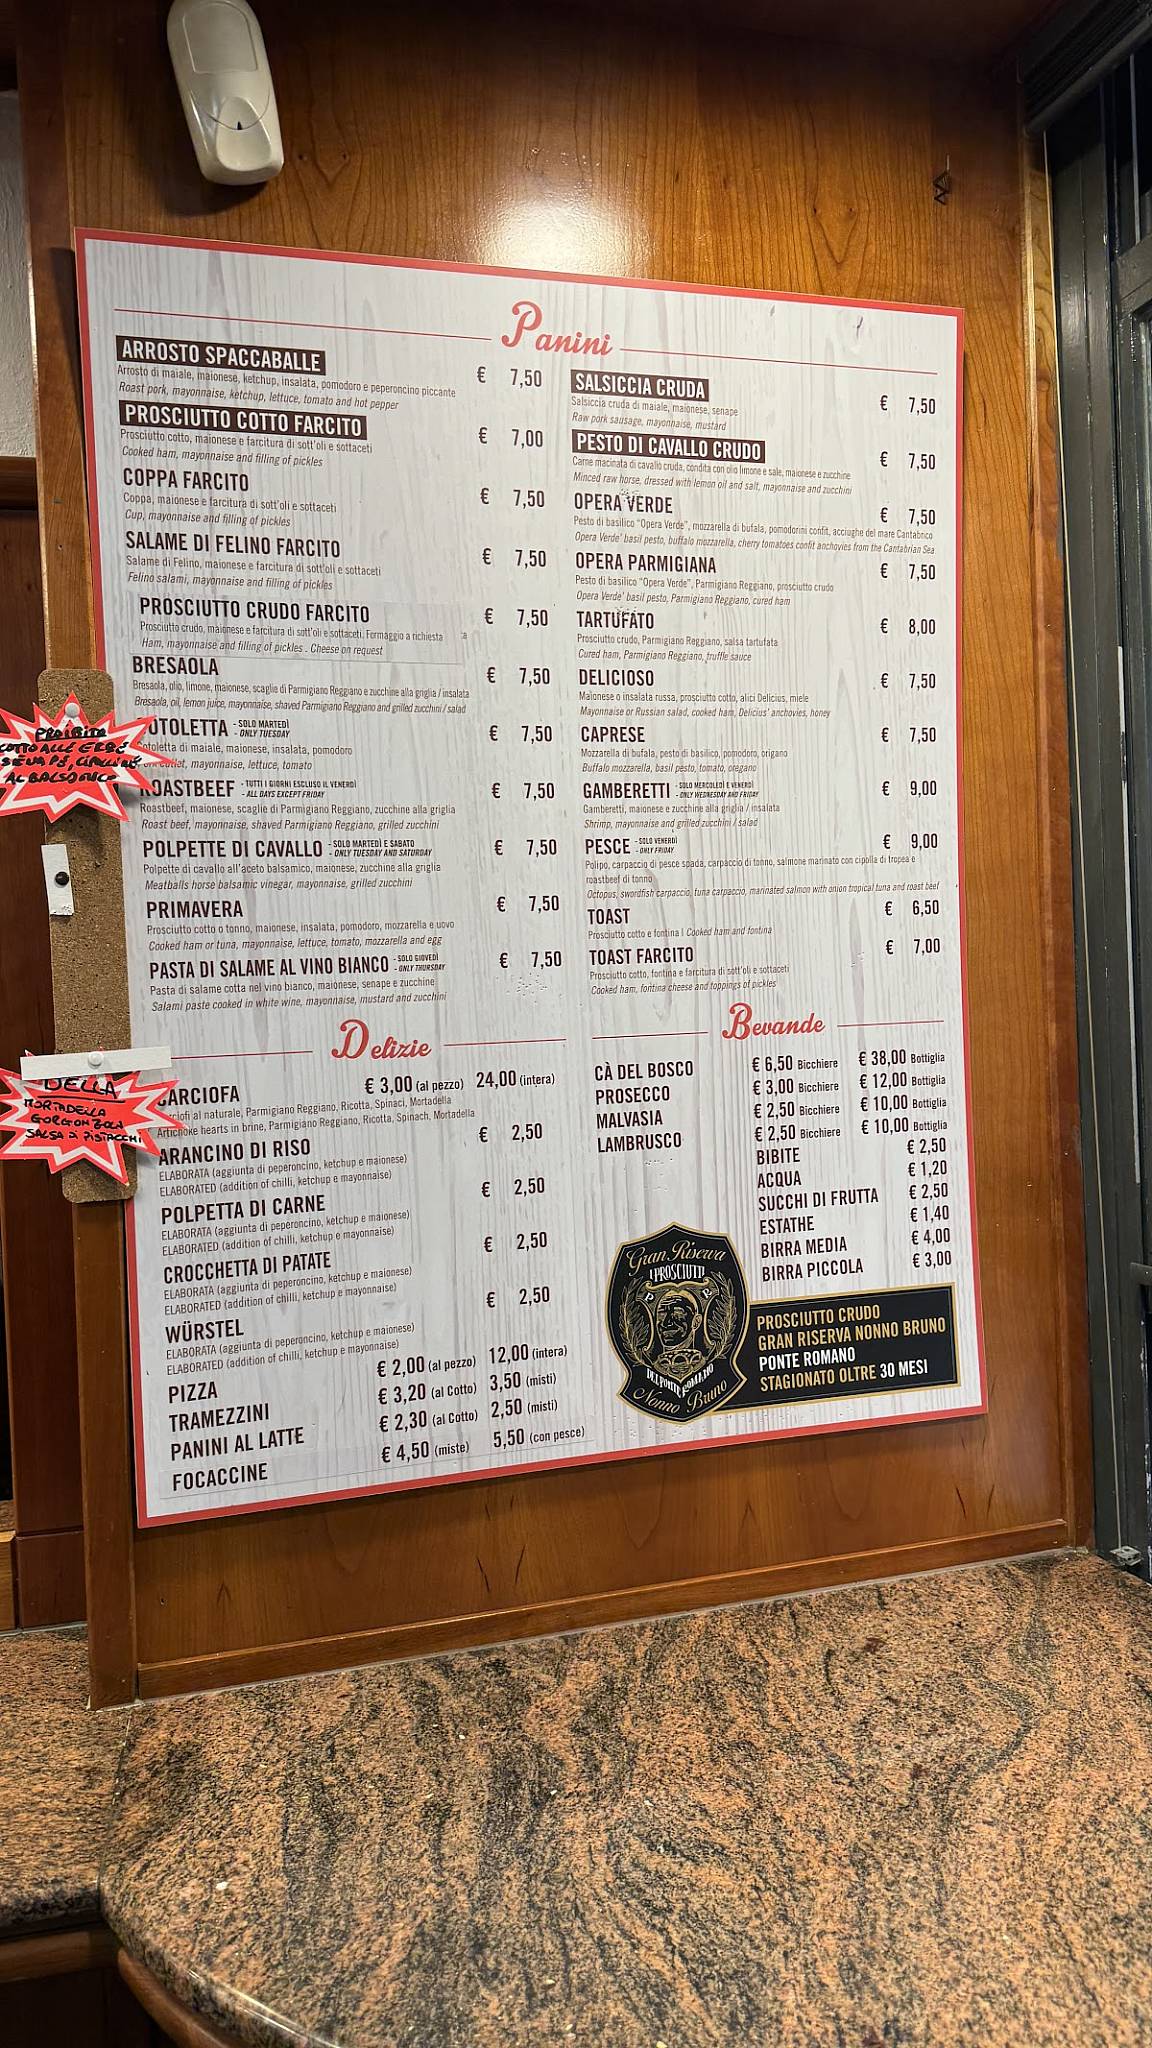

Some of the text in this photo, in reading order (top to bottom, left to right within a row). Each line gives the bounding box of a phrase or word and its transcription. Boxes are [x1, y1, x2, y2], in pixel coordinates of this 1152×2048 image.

[501, 300, 613, 356] Panini
[122, 339, 321, 372] ARROSTO SPACCABALLE
[117, 364, 456, 398] Arrosto di maiale, maionese, ketchup, insalata, pomodoro e peperoncino piccante
[476, 366, 542, 388] € 7,50
[575, 372, 705, 399] SALSICCIA CRUDA
[125, 404, 361, 436] PROSCIUTTO COTTO FARCITO
[122, 445, 323, 467] Cooked ham, mayonnaise and filling of pickles
[576, 432, 761, 460] PESTO DI CAVALLO CRUDO
[879, 450, 936, 471] € 7,50
[123, 467, 248, 491] COPPA FARCITO
[574, 492, 673, 514] OPERA VERDE
[125, 530, 340, 558] SALAME DI FELINO FARCITO
[575, 551, 716, 574] OPERA PARMIGIANA
[140, 597, 369, 623] PROSCIUTTO CRUDO FARCITO
[576, 610, 654, 629] TARTUFATO
[880, 617, 936, 636] € 8,00
[132, 655, 219, 675] BRESAOLA
[579, 668, 654, 686] DELICIOSO
[147, 717, 229, 737] OTOLETTA
[581, 726, 645, 742] CAPRESE
[580, 747, 788, 759] Mozzarella di bufala, pesto di basilico, pomodoro, origano
[583, 782, 670, 799] GAMBERETTI
[142, 840, 322, 858] POLPETTE DI CAVALLO
[585, 838, 631, 854] PESCE
[146, 900, 243, 918] PRIMAVERA
[587, 908, 630, 925] TOAST
[149, 955, 388, 979] PASTA DI SALAME AL VINO BIANCO
[588, 946, 693, 965] TOAST FARCITO
[722, 1002, 826, 1040] Bevande
[331, 1019, 432, 1059] Delizie
[751, 1054, 838, 1073] € 6,50 Bicchiere
[858, 1048, 945, 1067] € 38,00 Bottiglia
[594, 1060, 693, 1081] CÀ DEL BOSCO
[44, 1077, 117, 1099] DELLA
[364, 1075, 464, 1096] € 3,00 (al pezzo)
[595, 1085, 670, 1105] PROSECCO
[596, 1109, 663, 1129] MALVASIA
[158, 1138, 310, 1166] ARANCINO DI RISO
[597, 1131, 681, 1153] LAMBRUSCO
[159, 1153, 407, 1181] ELABORATA (aggiunta di peperoncino, ketchup e maionese)
[756, 1147, 800, 1165] BIBITE
[757, 1170, 802, 1189] ACQUA
[161, 1194, 325, 1225] POLPETTA DI CARNE
[758, 1187, 879, 1212] SUCCHI DI FRUTTA
[759, 1215, 814, 1235] ESTATHE
[627, 1239, 726, 1276] Gran Riserva
[760, 1236, 847, 1258] BIRRA MEDIA
[163, 1251, 331, 1284] CROCCHETTA DI PATATE
[762, 1258, 863, 1282] BIRRA PICCOLA
[757, 1304, 880, 1331] PROSCIUTTO CRUDO
[164, 1318, 244, 1344] WÜRSTEL
[758, 1316, 945, 1351] GRAN RISERVA NONNO BRUNO
[758, 1346, 855, 1371] PONTE ROMANO
[760, 1358, 928, 1391] STAGIONATO OLTRE 30 MESI
[168, 1381, 218, 1404] PIZZA
[633, 1380, 727, 1414] Nonno Bruno
[168, 1402, 269, 1432] TRAMEZZINI
[170, 1426, 304, 1461] PANINI AL LATTE
[493, 1425, 584, 1450] 5,50 (con pesce)
[172, 1462, 268, 1491] FOCACCINE
